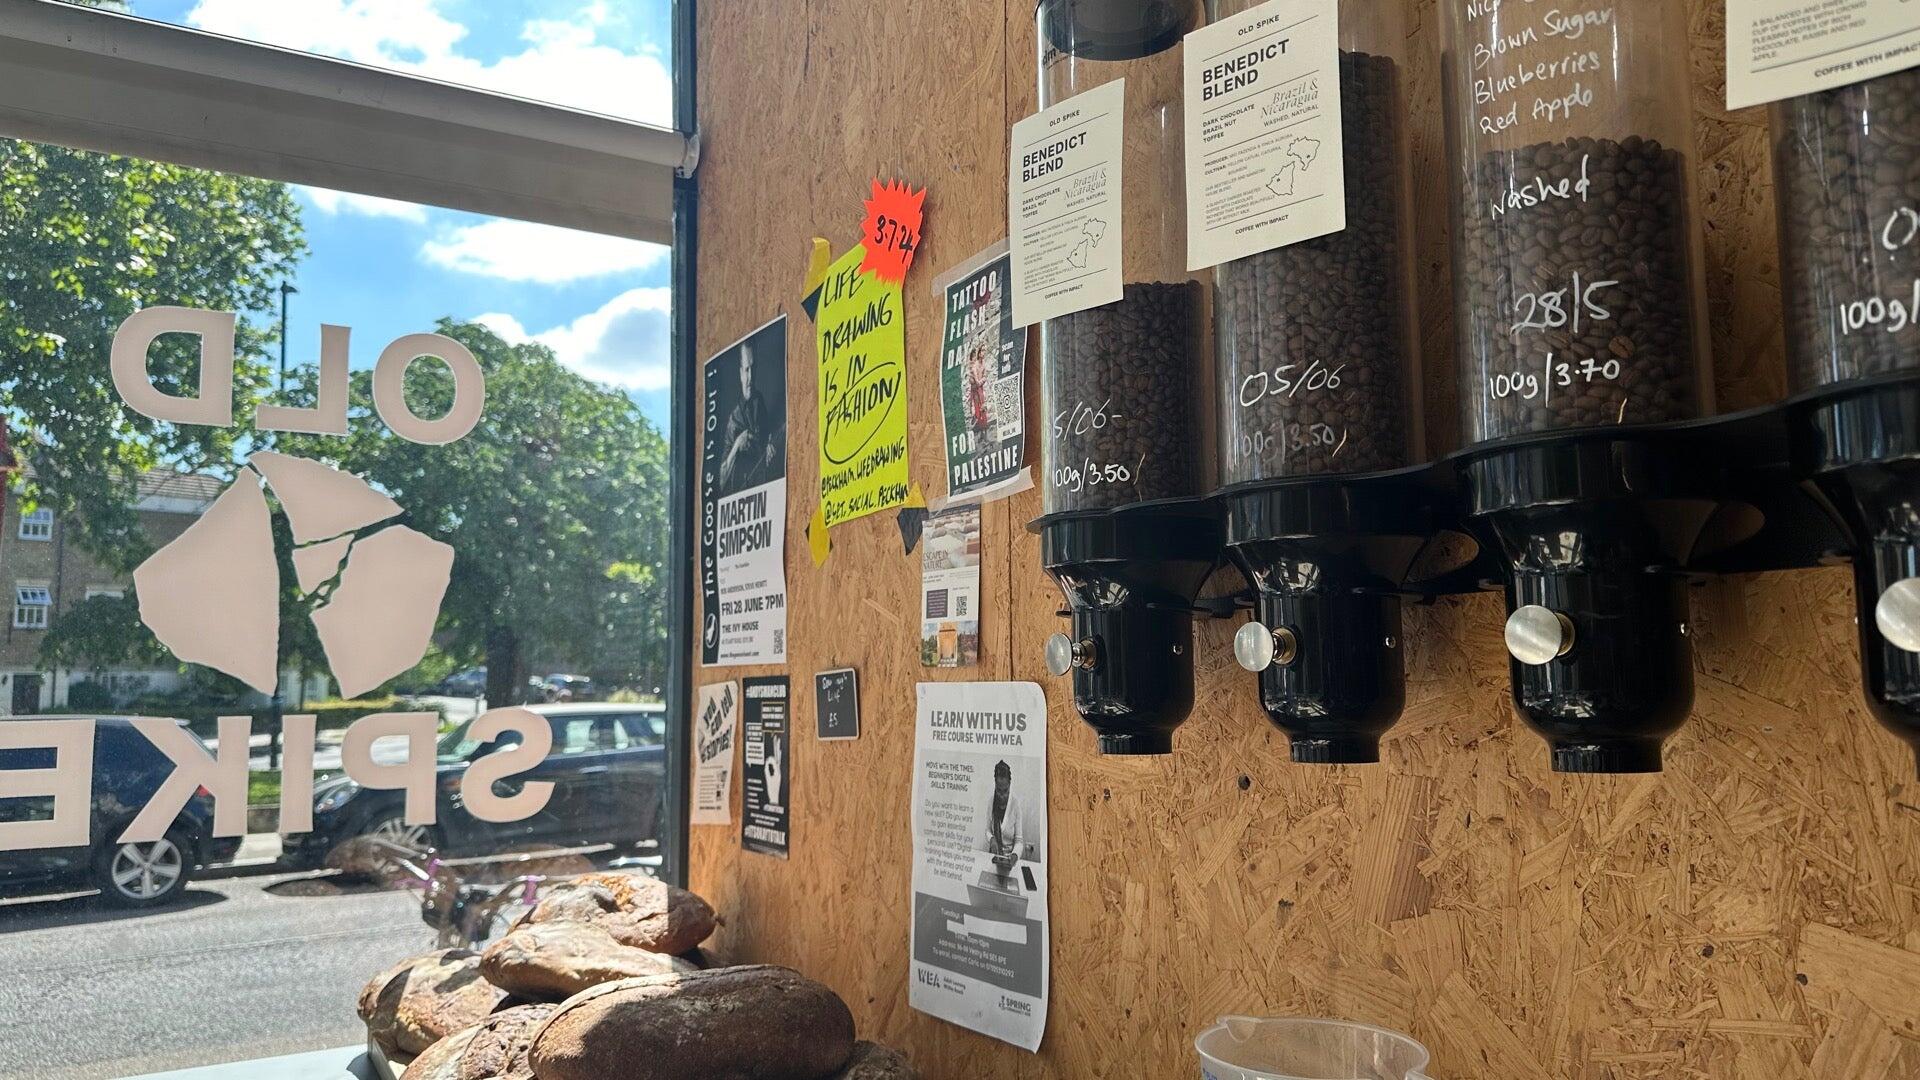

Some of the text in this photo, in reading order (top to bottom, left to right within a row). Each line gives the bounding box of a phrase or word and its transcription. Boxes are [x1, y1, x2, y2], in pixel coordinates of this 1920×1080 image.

[1238, 15, 1280, 36] OLD SPIKE
[1543, 8, 1613, 39] Sugar
[1203, 39, 1290, 84] BENEDICT
[1814, 62, 1853, 77] COFFEE
[1855, 54, 1882, 67] WITH
[1203, 69, 1259, 101] BLEND
[1273, 80, 1306, 104] Brazil
[1475, 51, 1601, 105] Blueberries
[1049, 109, 1080, 127] OLD SPIKE
[1203, 104, 1255, 127] DARK CHOCOLATE
[1292, 104, 1319, 117] NATURAL
[1479, 102, 1518, 135] Red
[1203, 119, 1237, 135] BRAZIL NUT
[1203, 132, 1224, 143] TOFFEE
[1022, 132, 1087, 168] BENEDICT
[1022, 157, 1063, 183] BLEND
[1235, 214, 1289, 234] COFFEE WITH IMPACT
[824, 262, 864, 308] LIFE
[952, 270, 996, 313] TATTOO
[822, 292, 893, 365] DRAWING
[950, 304, 986, 341] FLASH
[947, 341, 971, 370] DAY
[824, 353, 867, 404] IS IN
[1240, 360, 1346, 406] 05/06
[826, 377, 893, 437] FASHION
[952, 431, 975, 456] FOR
[954, 445, 1018, 486] PALESTINE
[704, 472, 714, 546] Goose
[720, 491, 767, 530] MARTIN
[720, 520, 772, 558] SIMPSON
[705, 556, 715, 597] The
[722, 594, 783, 616] FRI 28 JUNE 7PM
[722, 624, 731, 633] THE
[742, 621, 759, 631] HOUSE
[931, 711, 1027, 731] LEARN WITH US
[932, 730, 1023, 746] FREE COURSE WITH WEA
[954, 773, 972, 783] DIGITAL
[918, 968, 940, 988] WEA
[1007, 998, 1031, 1011] SPRING
